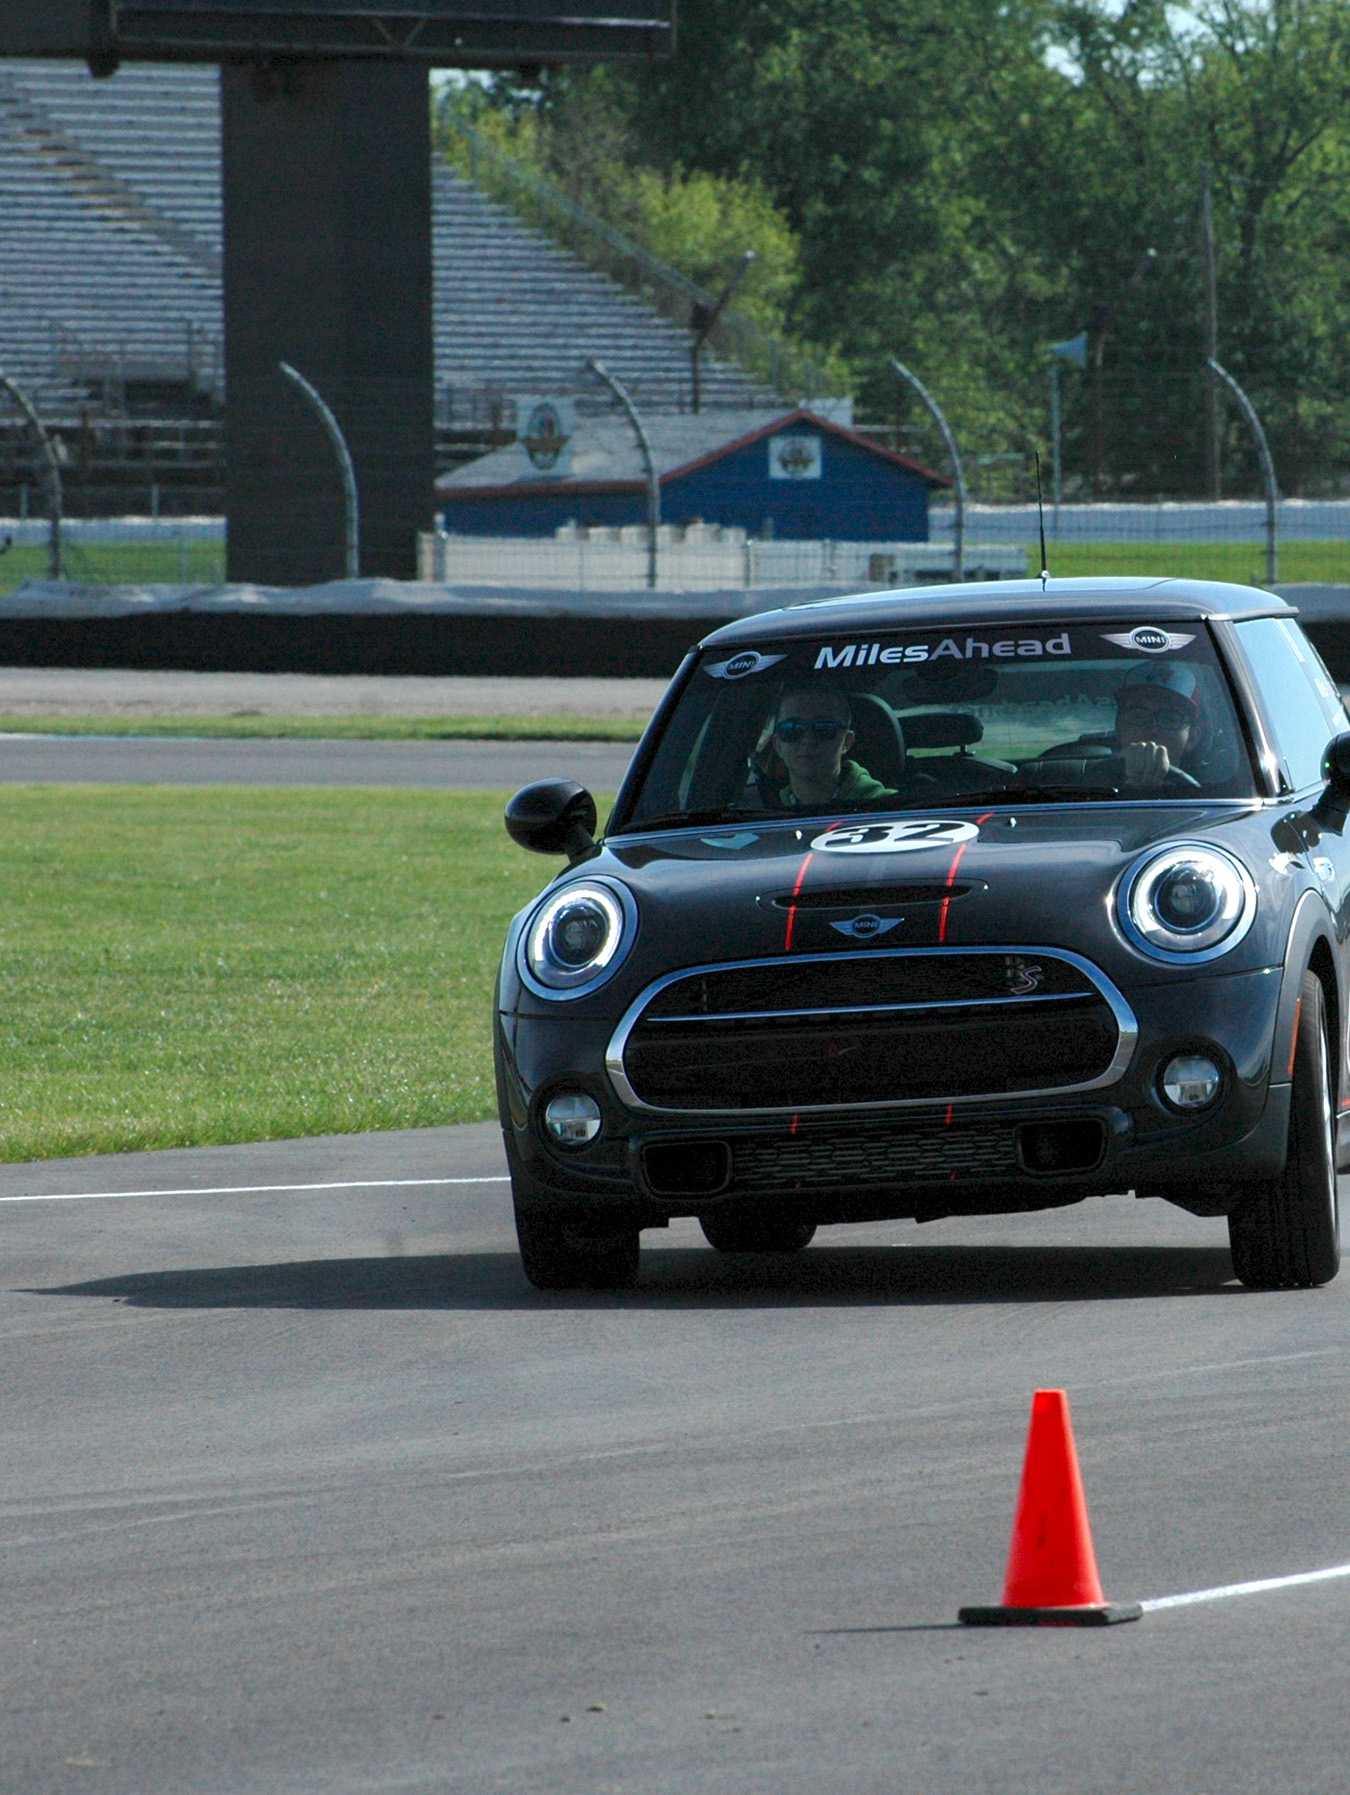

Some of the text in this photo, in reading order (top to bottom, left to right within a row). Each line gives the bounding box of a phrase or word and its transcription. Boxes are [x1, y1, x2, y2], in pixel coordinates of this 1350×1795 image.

[1135, 635, 1166, 644] MINI
[814, 632, 1072, 670] MilesAhead
[729, 659, 755, 671] MINI
[825, 822, 966, 848] 32
[854, 921, 878, 929] MINI
